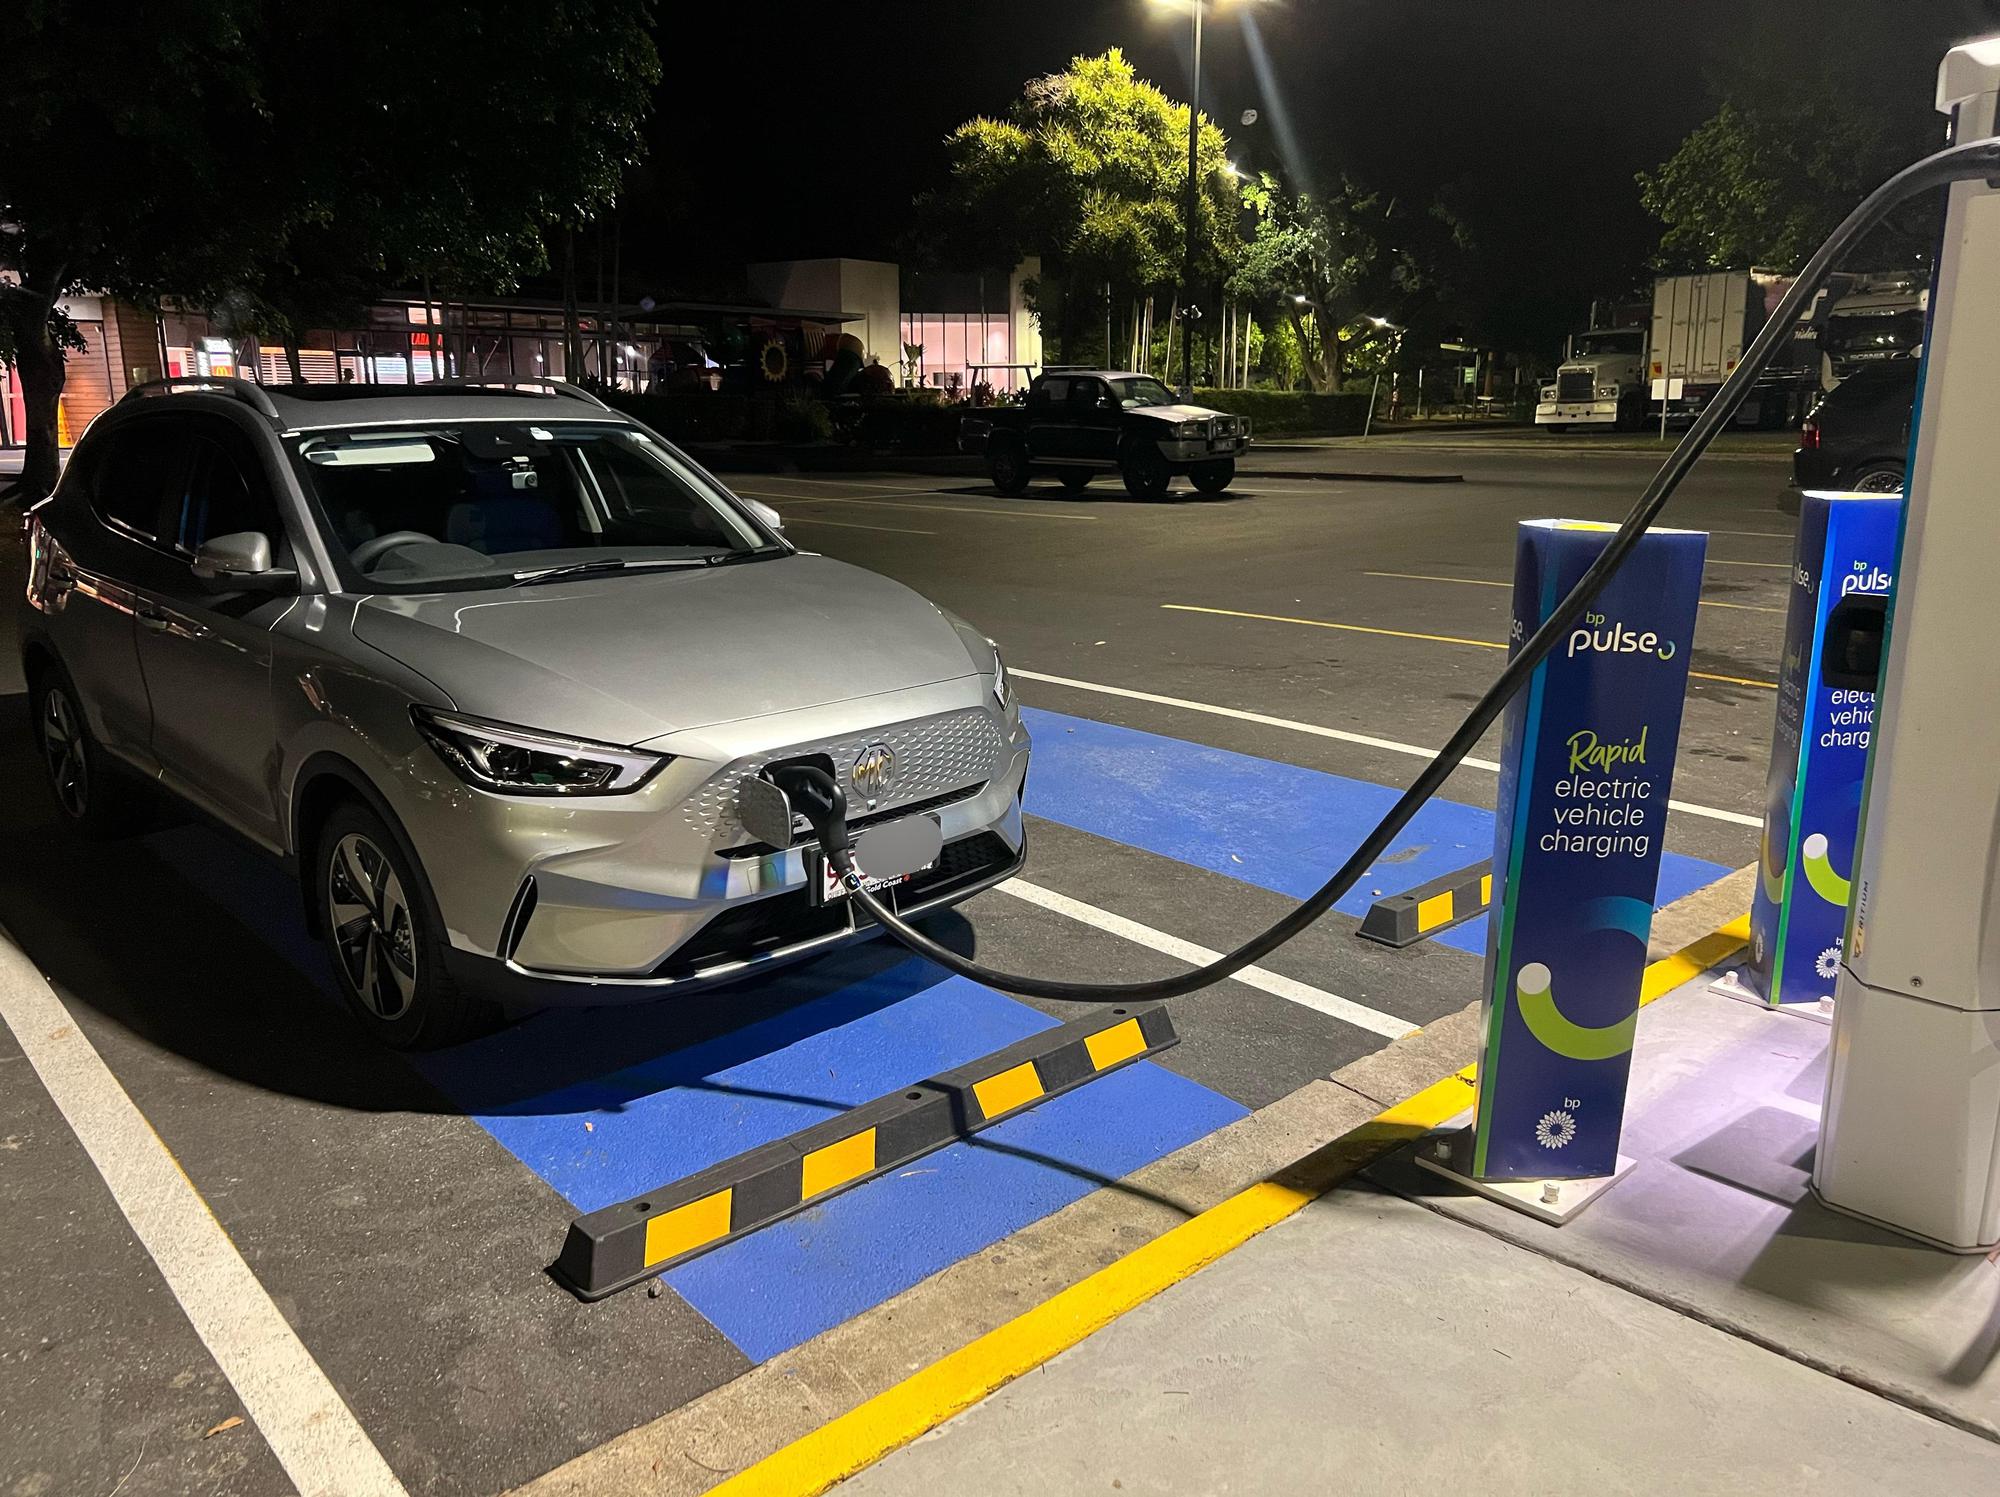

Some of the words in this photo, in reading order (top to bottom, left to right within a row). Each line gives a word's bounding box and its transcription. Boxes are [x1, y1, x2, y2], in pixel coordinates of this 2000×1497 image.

[1853, 560, 1868, 572] bp
[1841, 566, 1892, 598] puls
[1585, 610, 1606, 627] bp
[1567, 622, 1658, 658] pulse
[1831, 689, 1876, 705] elec
[1830, 705, 1875, 726] vehic
[1820, 728, 1871, 749] charg
[1565, 725, 1647, 775] Rapid
[1554, 775, 1652, 800] electric
[1553, 803, 1646, 827] vehicle
[1539, 830, 1651, 859] charging
[882, 877, 903, 889] Coast
[1857, 880, 1869, 936] TRITIUM
[1564, 1096, 1581, 1111] bp
